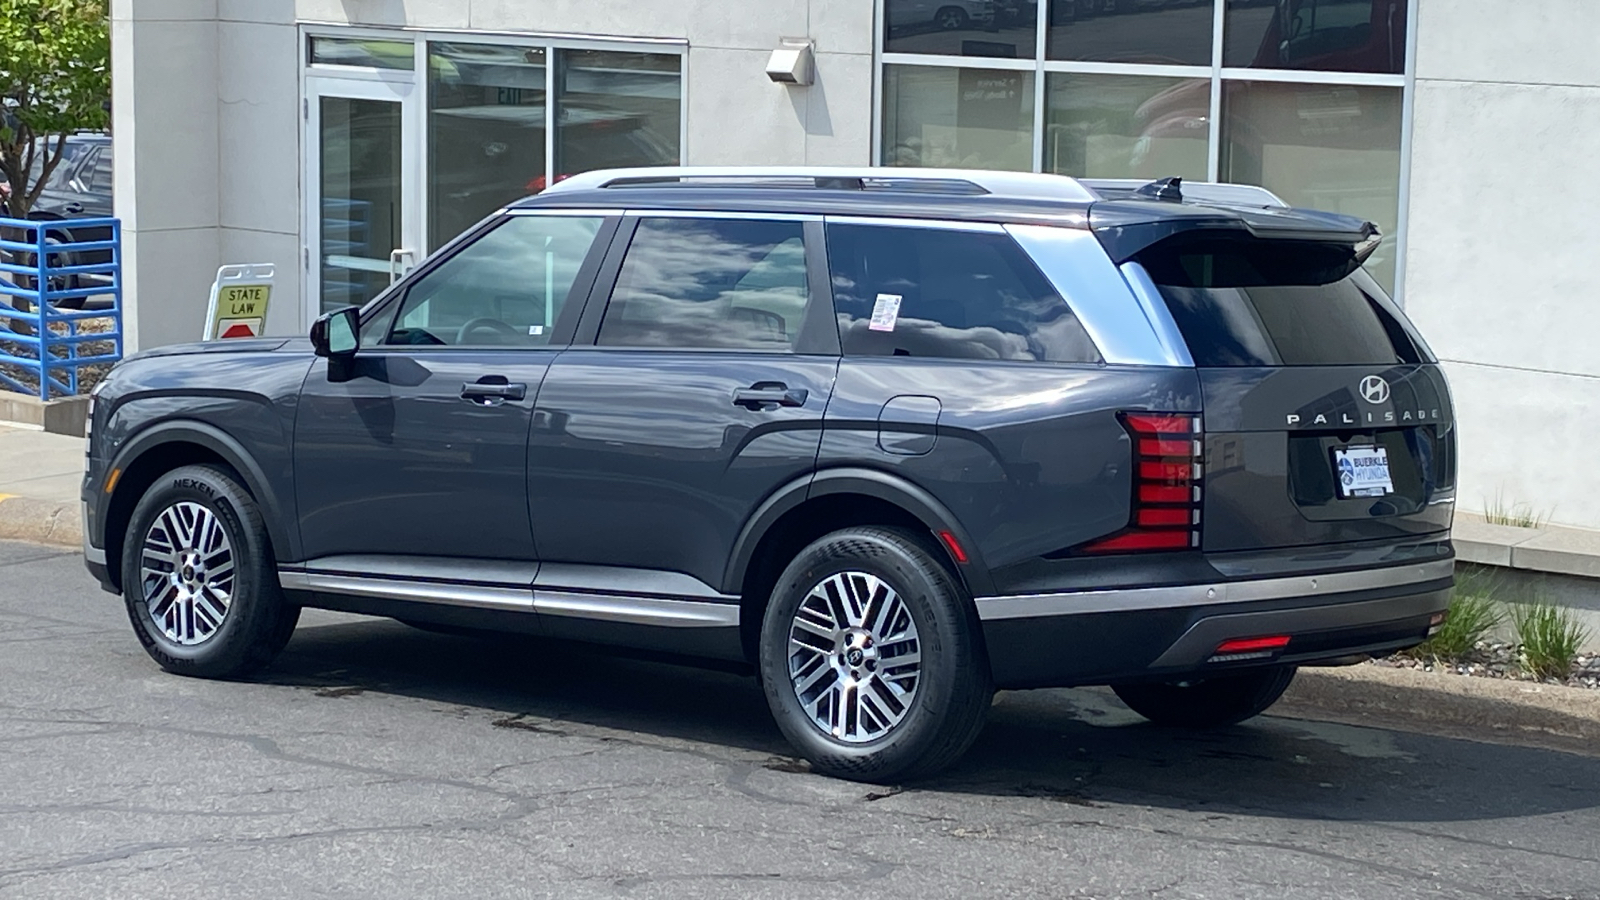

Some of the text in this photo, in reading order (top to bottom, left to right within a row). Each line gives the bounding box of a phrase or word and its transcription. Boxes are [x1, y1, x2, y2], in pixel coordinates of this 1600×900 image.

[228, 288, 262, 301] STATE
[231, 303, 255, 315] LAW
[1286, 409, 1439, 425] PALISADE
[1353, 456, 1388, 468] BUERKLE
[1355, 466, 1389, 480] HYUNDA
[173, 478, 215, 498] NEXEN
